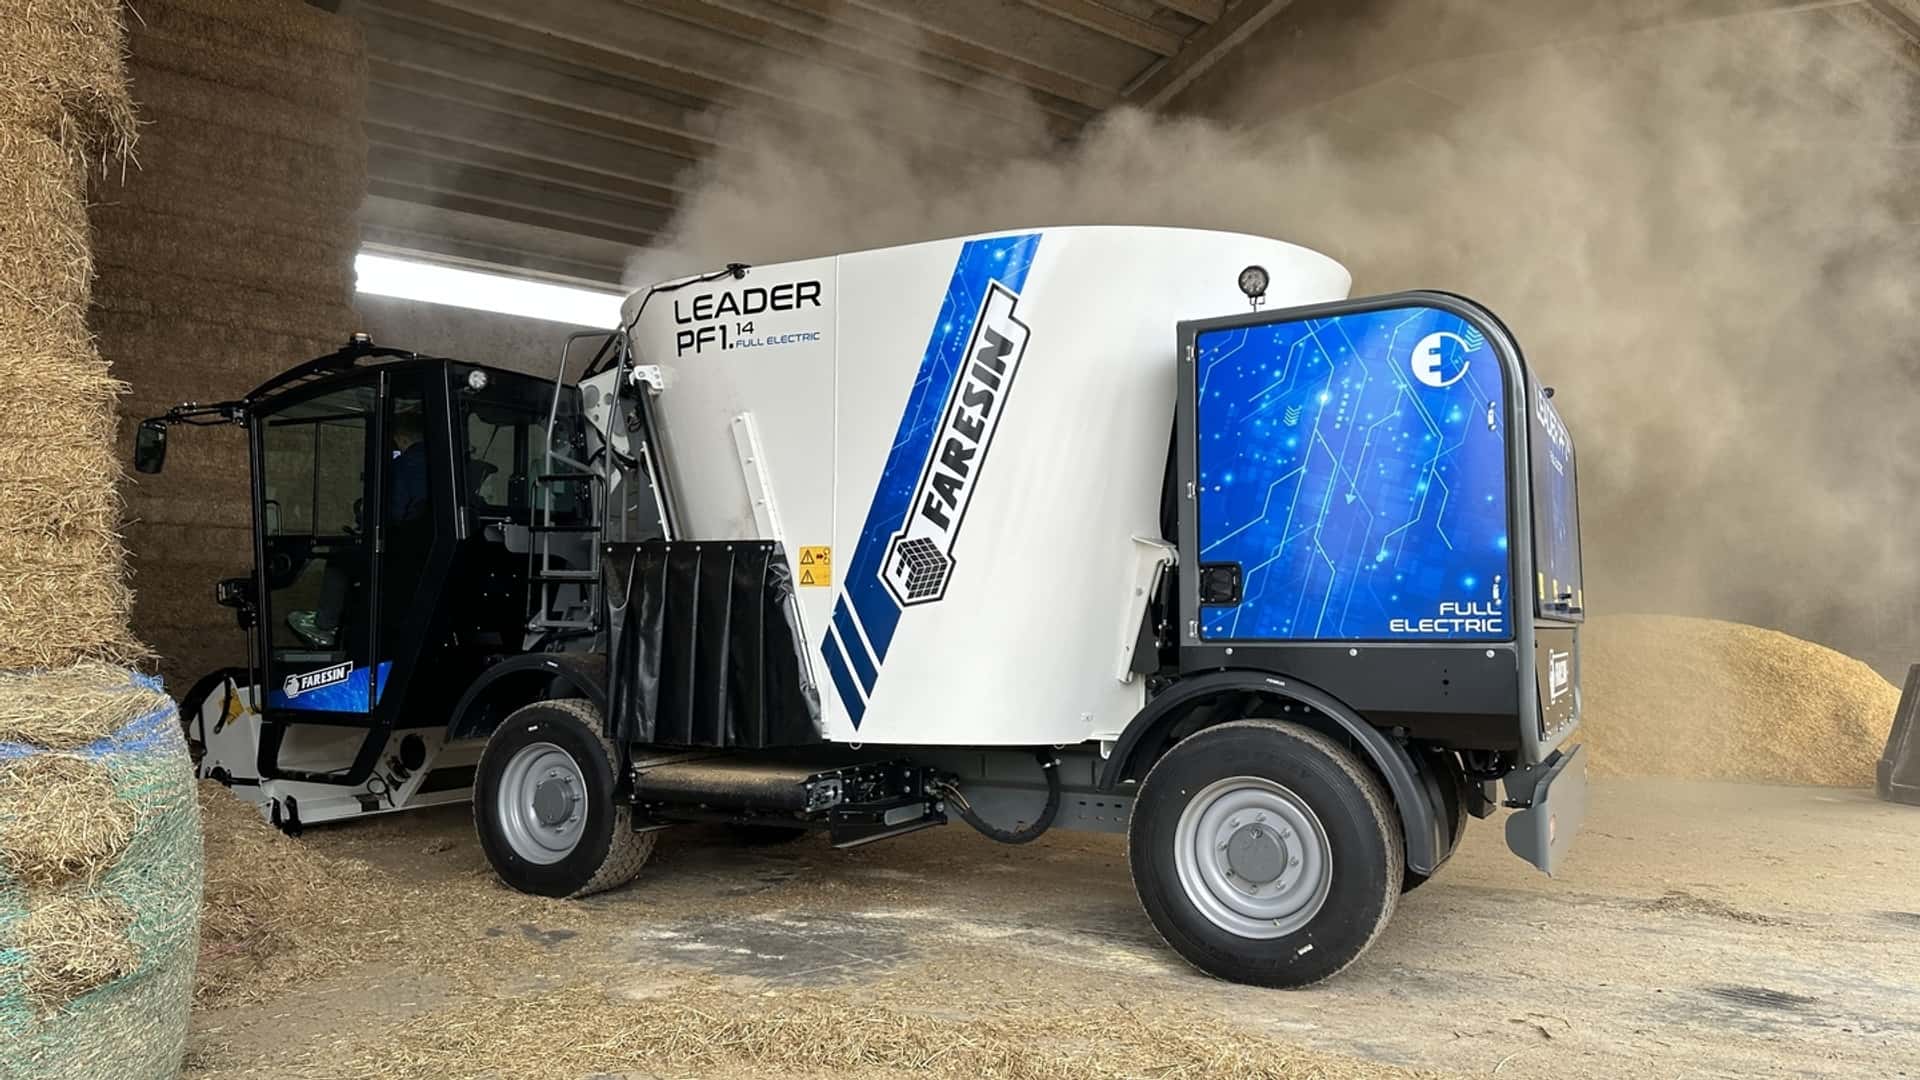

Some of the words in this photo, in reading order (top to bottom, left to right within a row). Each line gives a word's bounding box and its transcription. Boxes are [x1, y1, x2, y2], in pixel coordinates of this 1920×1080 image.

[674, 280, 821, 324] LEADER
[736, 321, 754, 336] 14
[736, 338, 764, 348] FULL
[767, 332, 820, 345] ELECTRIC
[921, 325, 1014, 532] FARESIN
[1440, 602, 1502, 615] FULL
[1390, 619, 1502, 632] ELECTRIC
[301, 667, 345, 689] FARESIN
